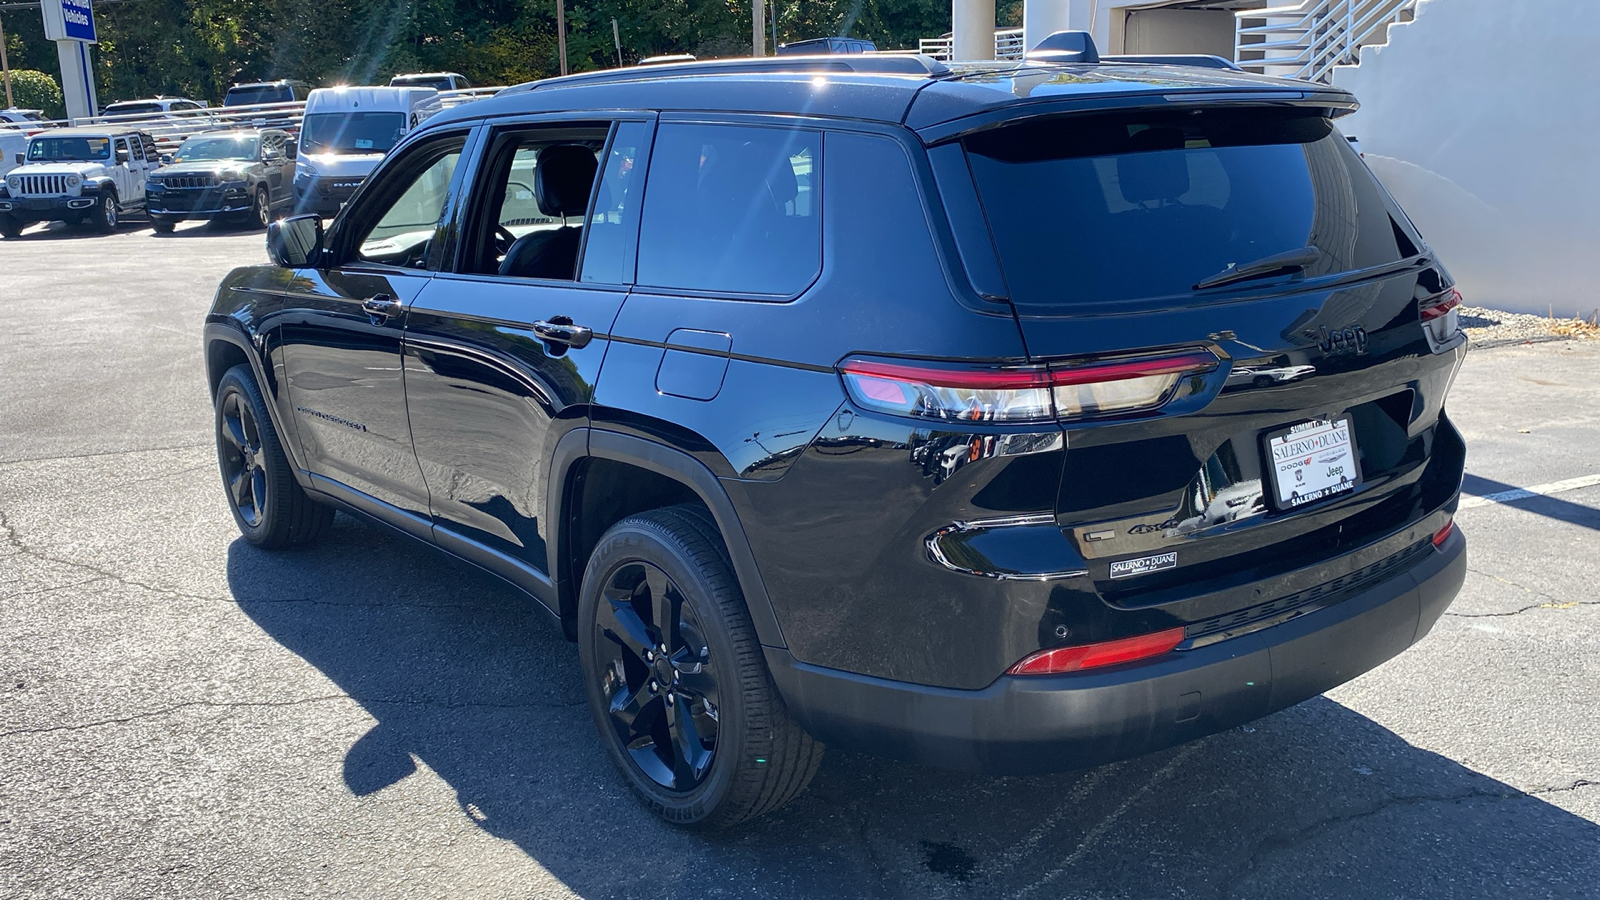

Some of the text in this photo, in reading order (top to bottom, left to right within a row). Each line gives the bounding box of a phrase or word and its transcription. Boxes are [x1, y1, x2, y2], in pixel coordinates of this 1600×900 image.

[64, 8, 88, 25] Vehicles
[1317, 325, 1368, 355] Jeep
[1274, 430, 1347, 460] SALERNO DUANE
[1281, 460, 1308, 472] DODGE
[1326, 466, 1344, 478] Jeep
[1292, 481, 1353, 506] SALERNO DUANE
[1112, 554, 1175, 573] SALERNO DUANE
